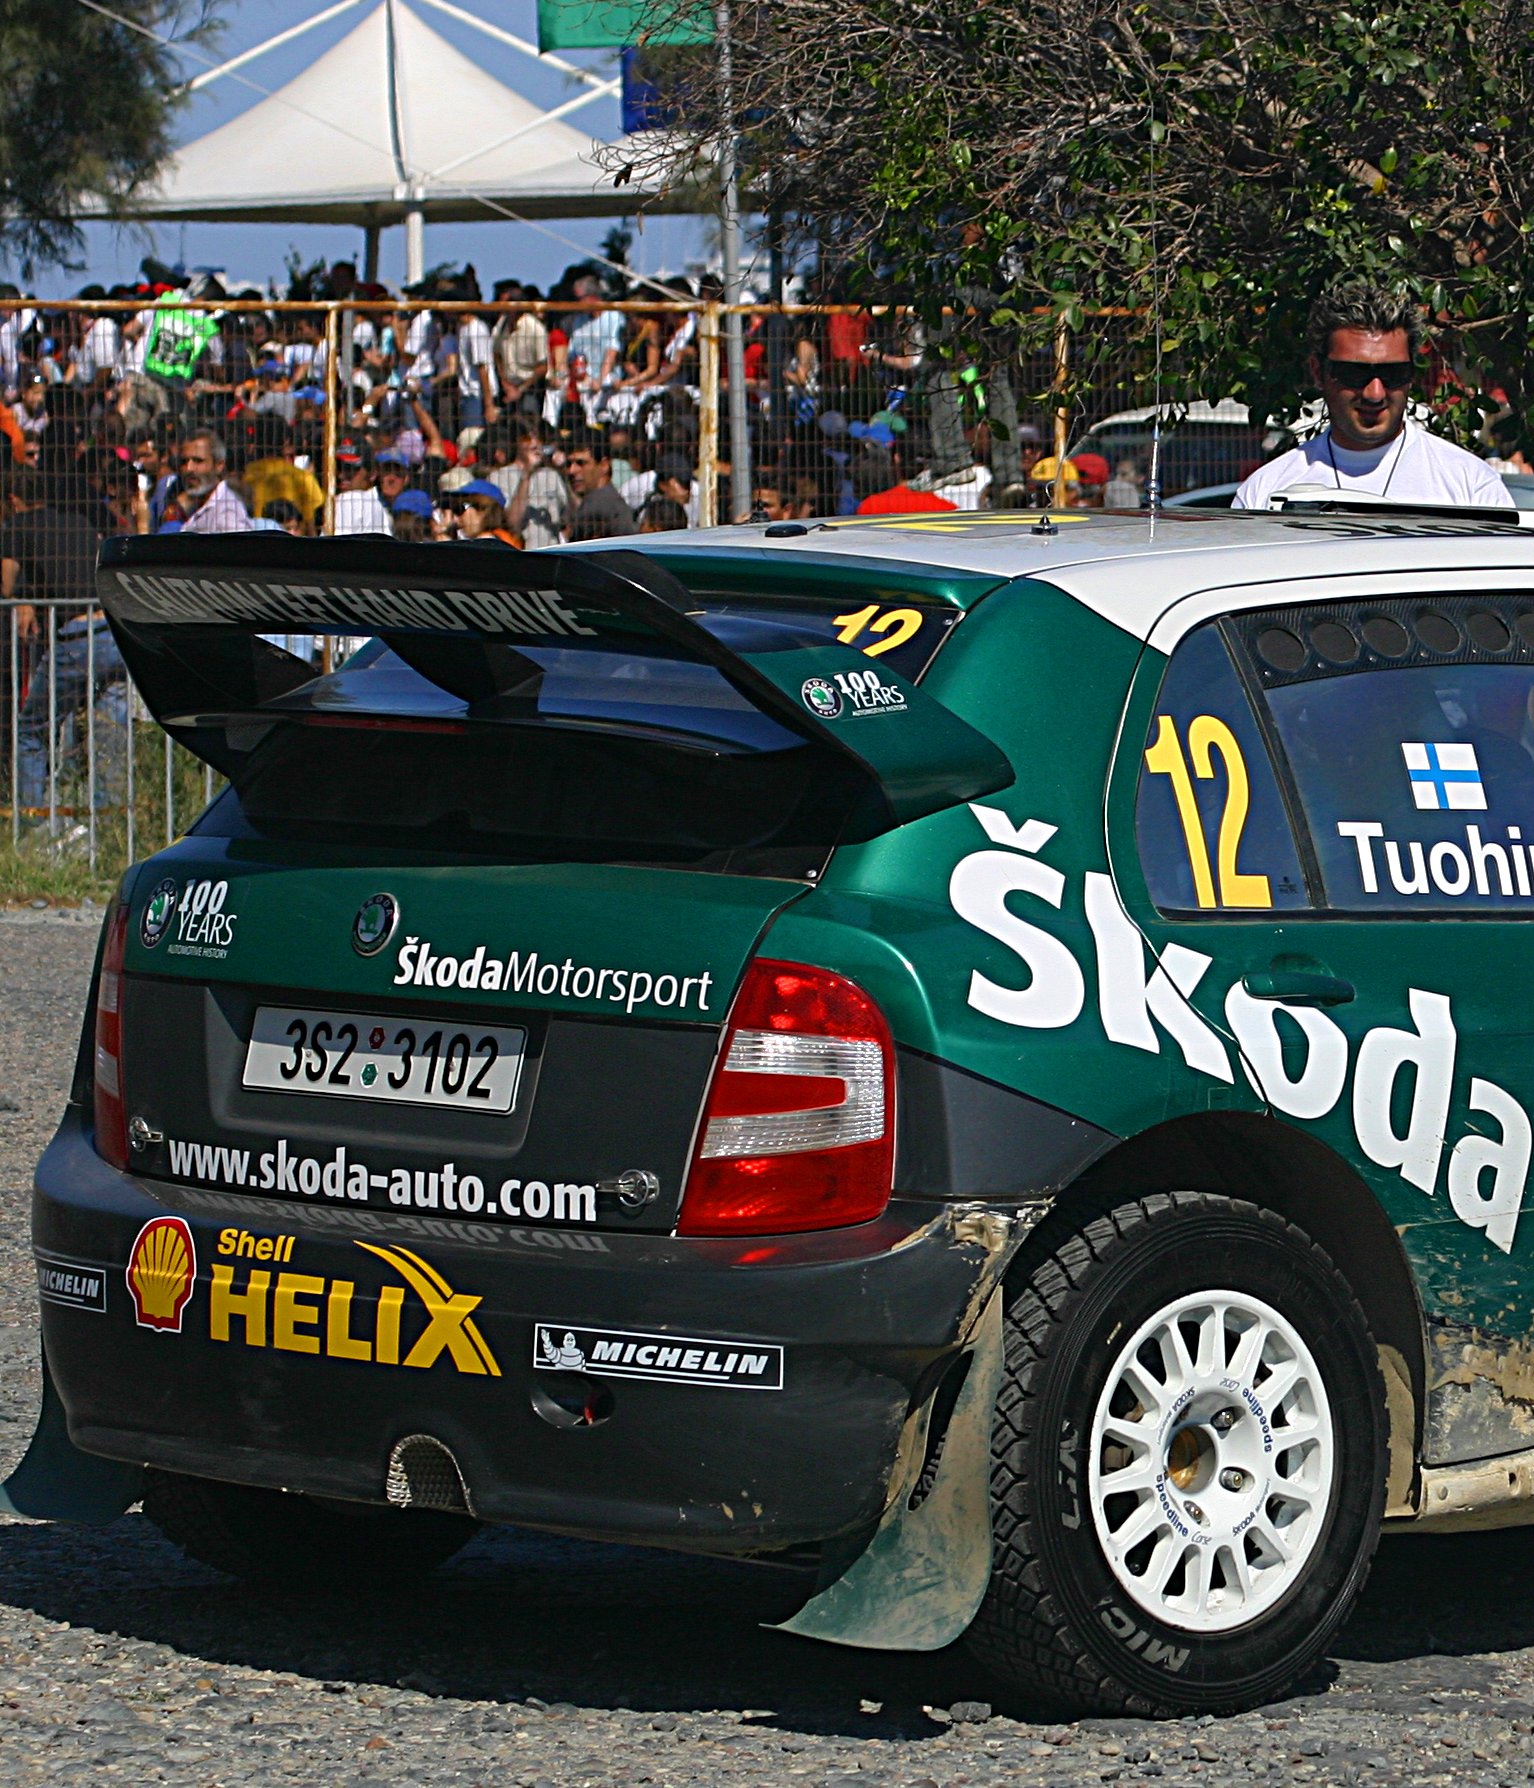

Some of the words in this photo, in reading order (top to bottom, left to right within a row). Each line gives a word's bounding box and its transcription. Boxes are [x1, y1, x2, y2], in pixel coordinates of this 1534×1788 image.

[115, 572, 287, 623] CAUTION
[249, 583, 361, 626] LEFT
[328, 587, 470, 631] HAND
[443, 590, 599, 636] DRIVE
[832, 604, 924, 658] 12
[834, 670, 881, 693] 100
[847, 685, 905, 709] YEARS
[1145, 714, 1273, 910] 12
[176, 910, 238, 946] YEARS
[178, 879, 229, 915] 100
[279, 1017, 360, 1087] 3S2
[387, 1023, 501, 1100] 3102
[948, 803, 1534, 1254] Škoda
[169, 1139, 598, 1222] www.skoda-auto.com
[217, 1227, 296, 1264] Shell
[209, 1240, 502, 1377] HELIX
[590, 1338, 769, 1376] MICHELIN
[1242, 1386, 1274, 1454] speedline
[1155, 1473, 1189, 1538] speedline
